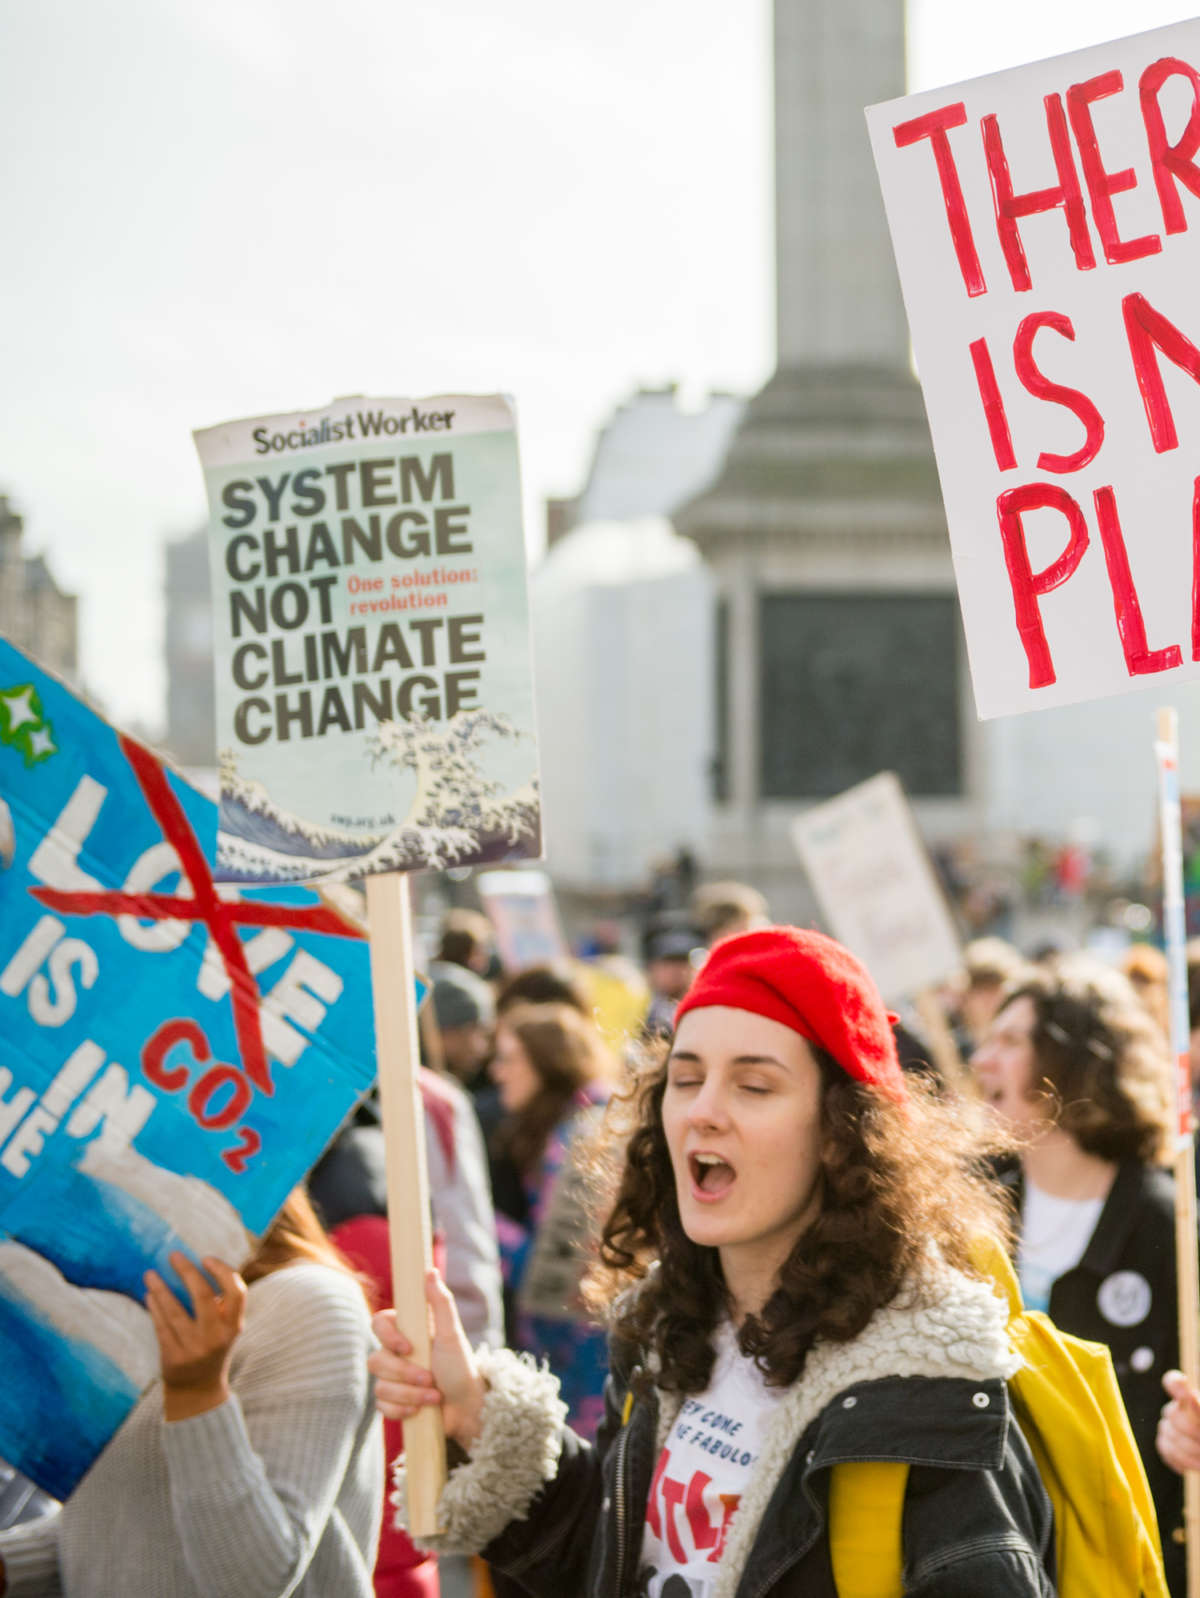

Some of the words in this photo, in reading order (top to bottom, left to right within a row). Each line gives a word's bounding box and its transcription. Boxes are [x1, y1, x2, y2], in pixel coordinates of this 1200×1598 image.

[969, 311, 1105, 474] IS
[253, 415, 355, 455] Socialist
[357, 408, 456, 438] Worker
[221, 452, 456, 529] SYSTEM
[225, 505, 474, 582] CHANGE
[347, 575, 384, 594] One
[391, 567, 478, 588] solution:
[229, 575, 338, 637] NOT
[350, 592, 448, 615] revolution
[232, 614, 486, 691] CLIMATE
[233, 670, 482, 745] CHANGE
[28, 774, 344, 1068] LOVE
[1, 916, 98, 1028] IS
[40, 1038, 157, 1152] IN
[690, 1432, 759, 1467] FABULO
[701, 1411, 743, 1436] COME
